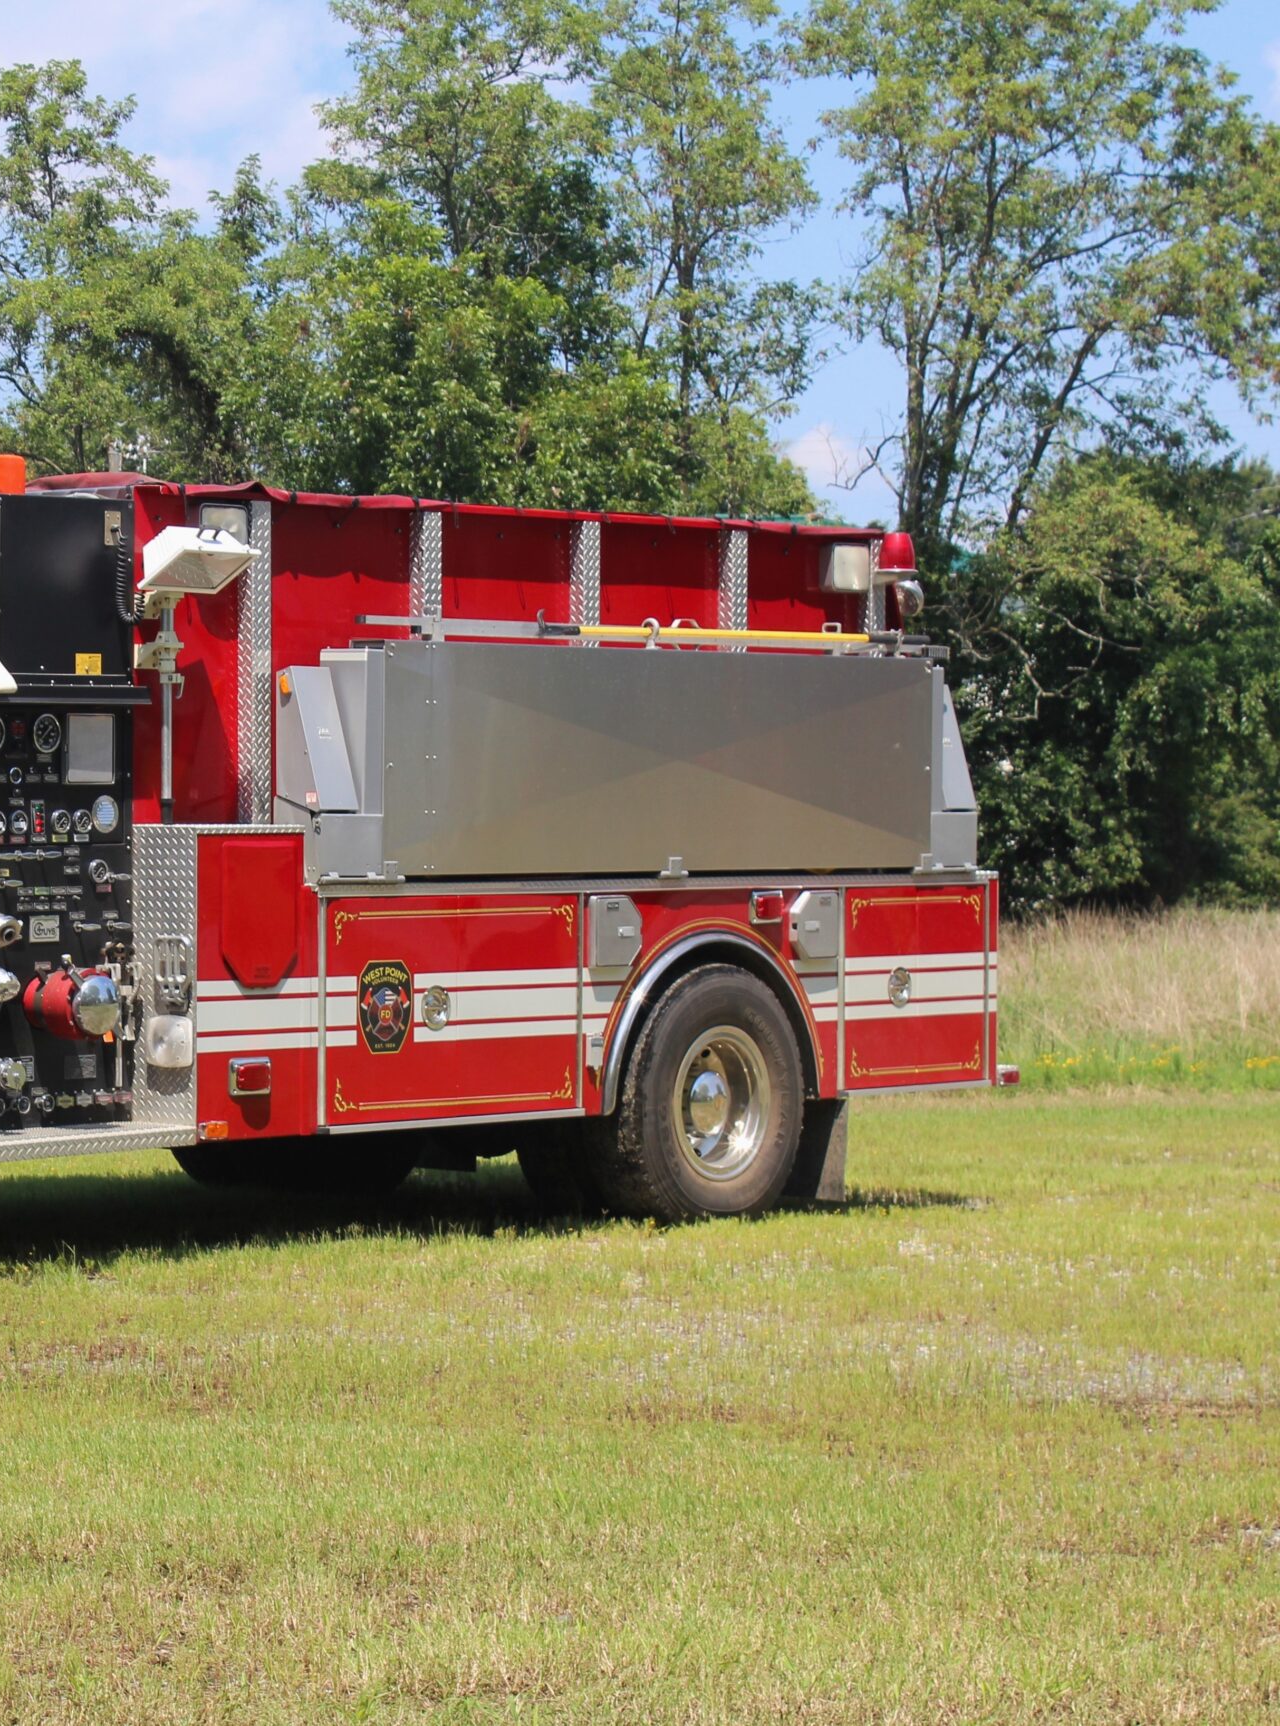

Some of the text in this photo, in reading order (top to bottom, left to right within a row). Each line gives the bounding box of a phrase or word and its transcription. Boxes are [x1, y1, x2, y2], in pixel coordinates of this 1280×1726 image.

[362, 966, 408, 985] WEST POINT
[380, 1009, 391, 1019] FD
